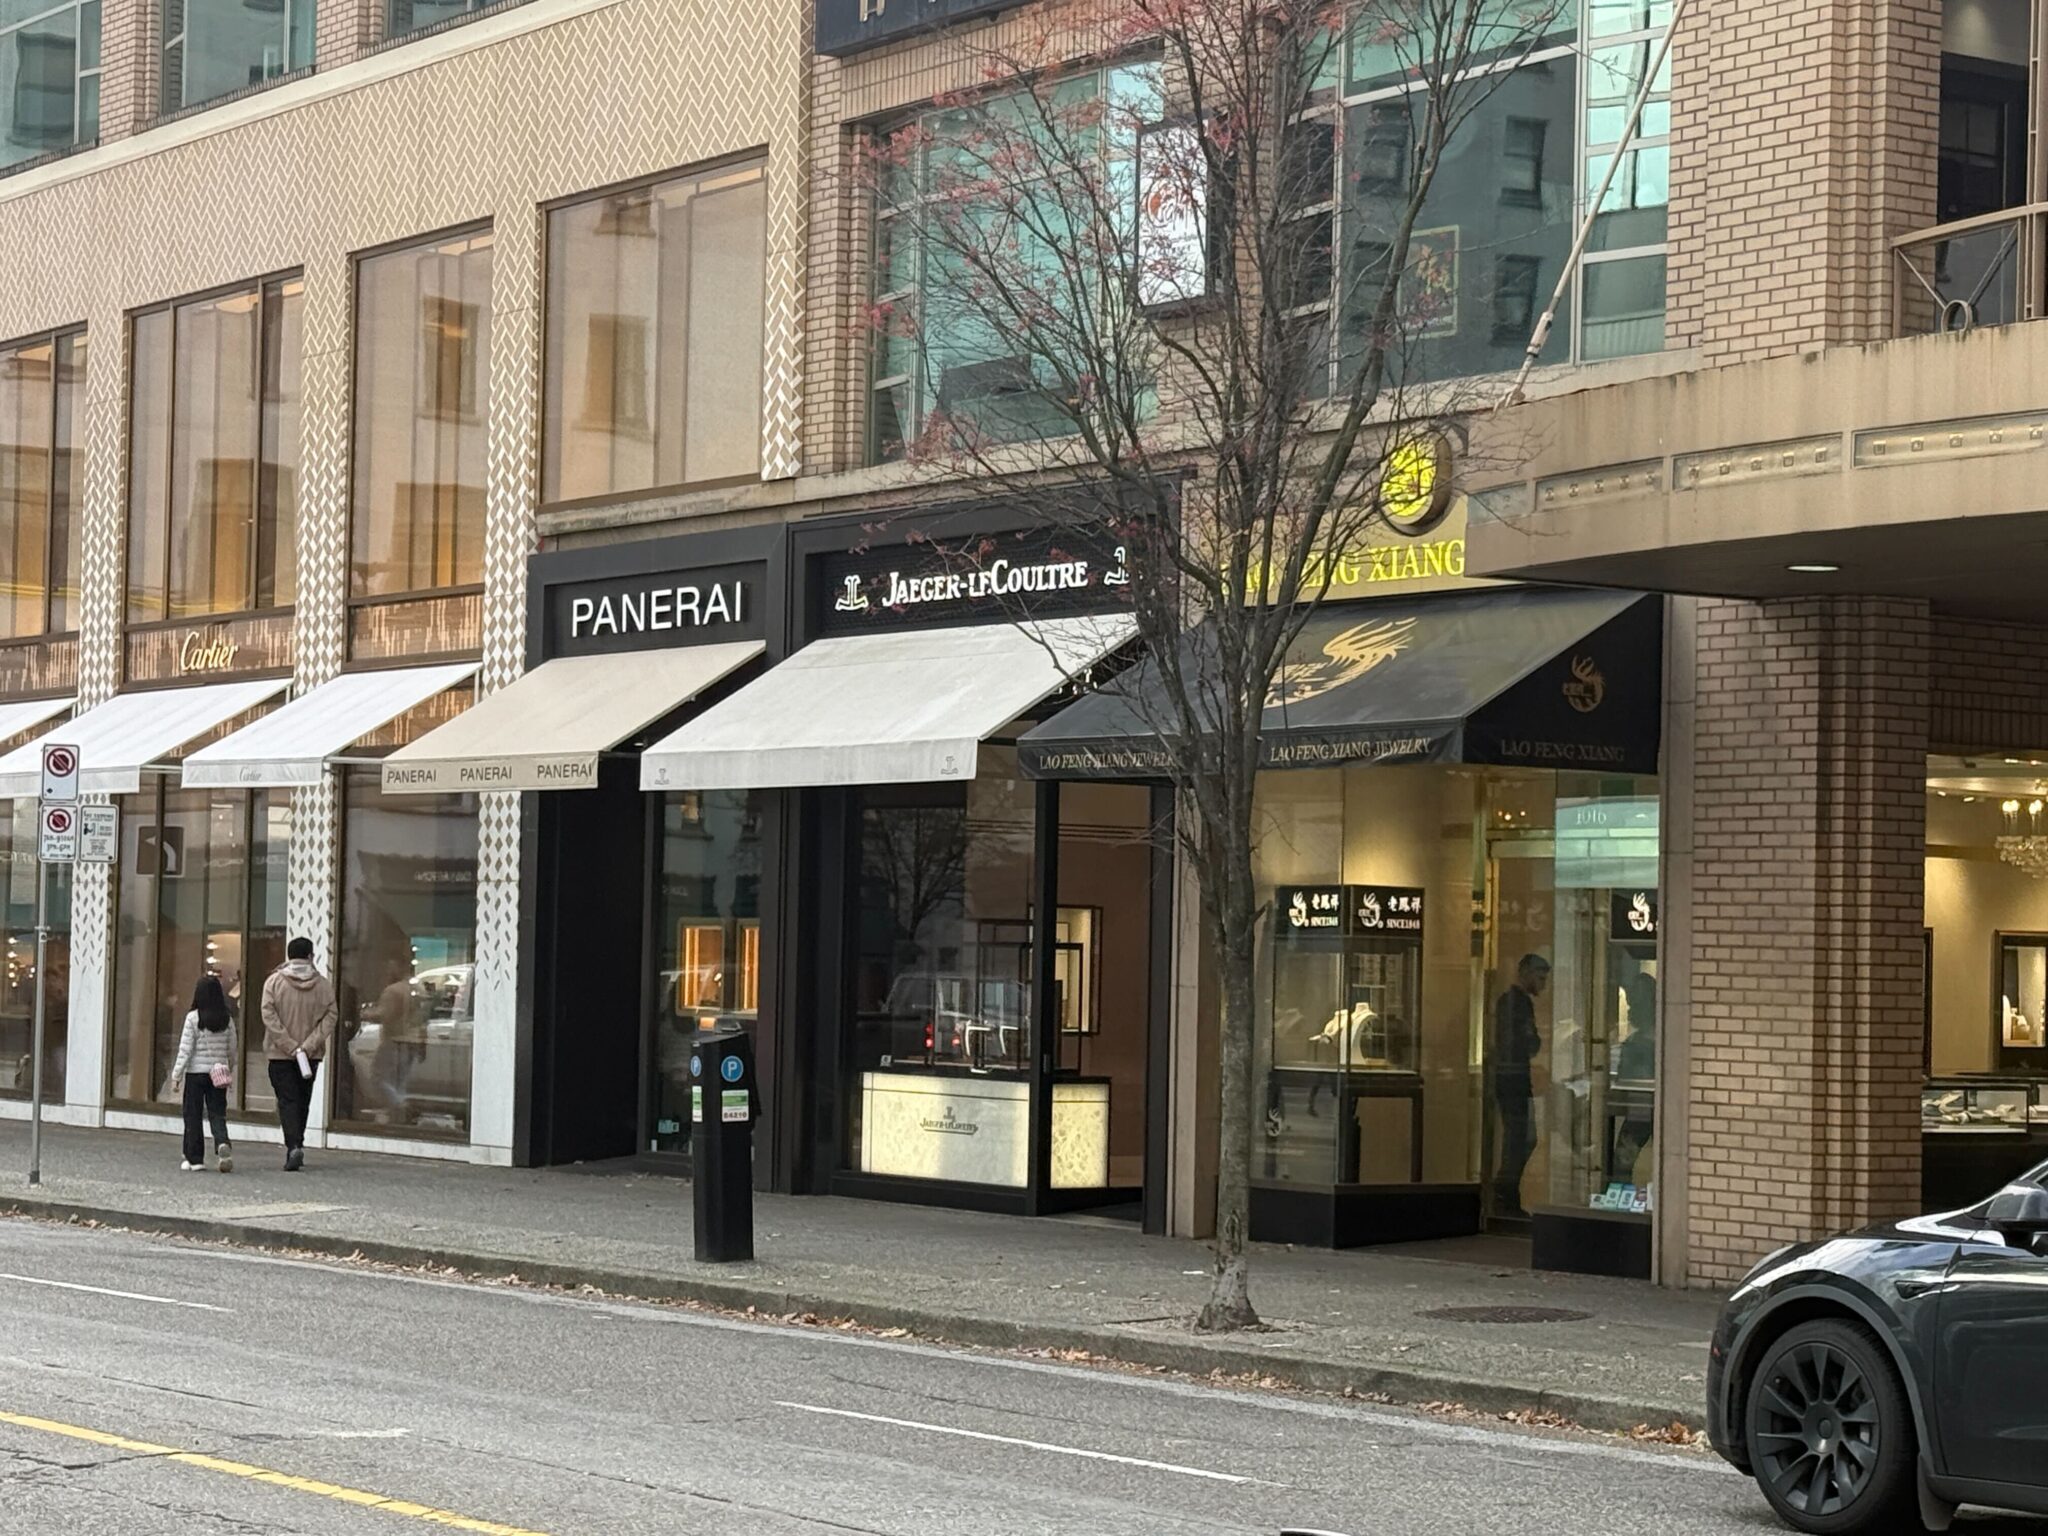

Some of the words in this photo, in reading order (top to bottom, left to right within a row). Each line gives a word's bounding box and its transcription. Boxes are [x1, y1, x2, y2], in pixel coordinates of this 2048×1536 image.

[1367, 539, 1465, 583] XIANG
[572, 581, 742, 637] PANERAI
[181, 631, 239, 670] Cartier
[1270, 747, 1294, 762] LAO
[1295, 744, 1329, 761] FENG
[1330, 741, 1371, 759] XIANG
[1373, 737, 1432, 757] JEWELRY
[1501, 739, 1530, 756] LAO
[1534, 741, 1574, 760] FENG
[1577, 744, 1625, 762] XIANG
[1039, 754, 1060, 770] LAO
[1061, 753, 1092, 769] FENG
[386, 769, 437, 784] PANERAI
[460, 766, 513, 782] PANERAI
[537, 763, 593, 779] PANERAI
[1577, 808, 1607, 825] 1016
[727, 1061, 738, 1077] P
